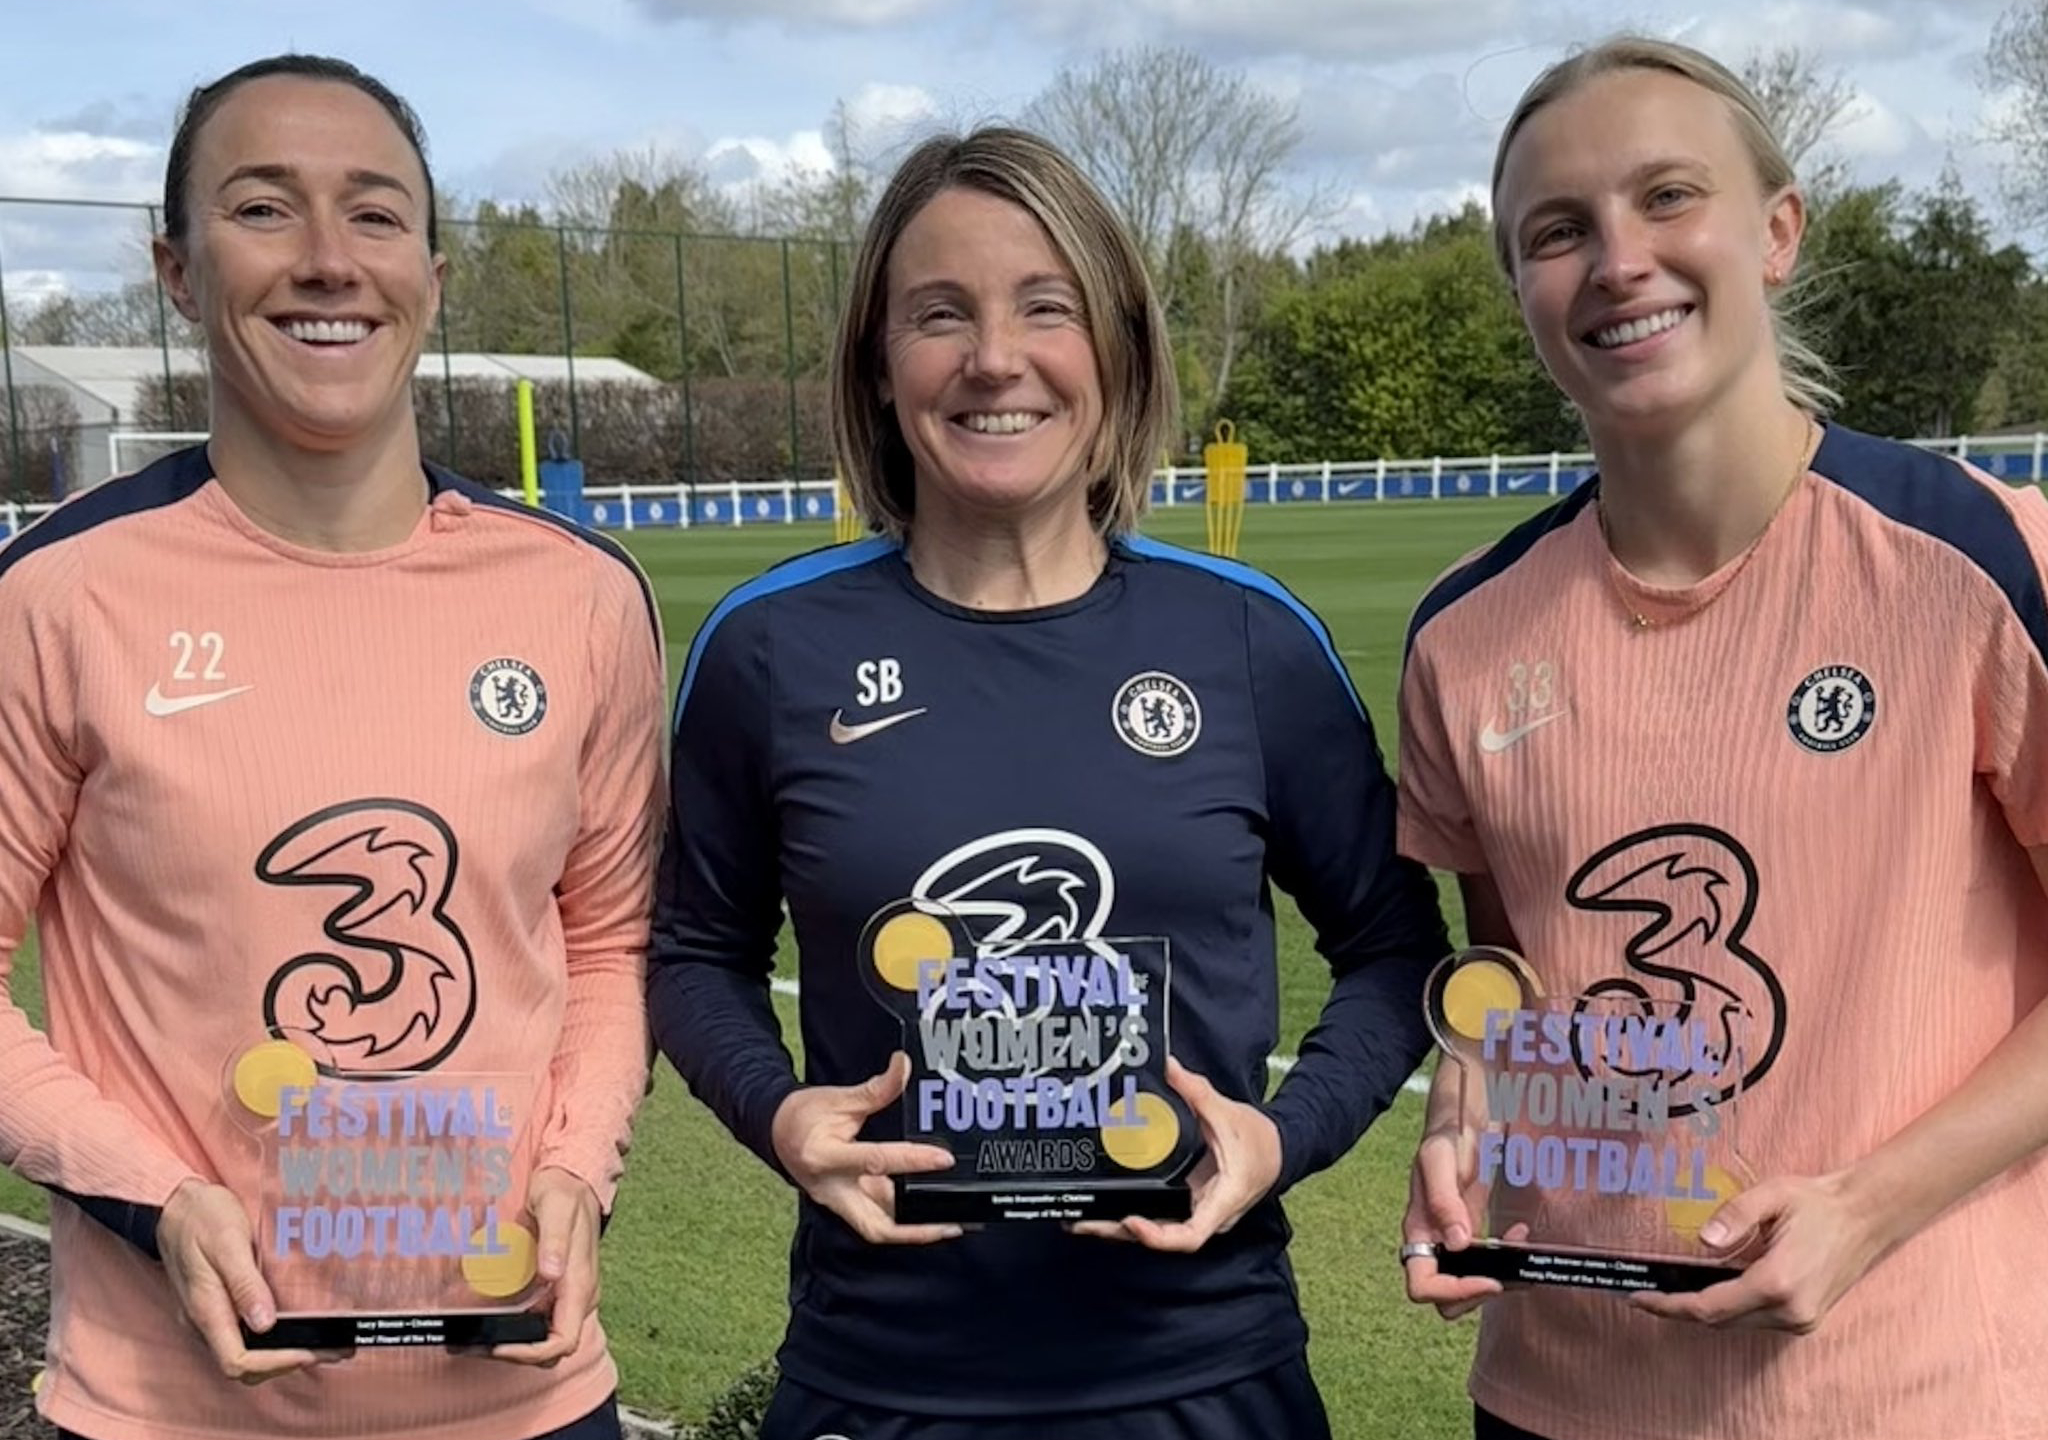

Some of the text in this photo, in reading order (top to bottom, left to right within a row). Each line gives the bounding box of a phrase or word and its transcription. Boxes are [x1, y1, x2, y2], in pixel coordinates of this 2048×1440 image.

[169, 630, 226, 680] 22
[480, 659, 533, 676] CHELSEA
[1804, 667, 1862, 687] CHELSEA
[857, 658, 904, 706] SB
[1128, 679, 1180, 698] CHELSEA
[1507, 662, 1552, 711] 33
[255, 797, 477, 1082] 3
[916, 954, 1149, 1010] FESTIVAL
[919, 1015, 1150, 1071] WOMEN'S
[1483, 1008, 1721, 1076] FESTIVAL
[278, 1085, 513, 1138] FESTIVAL
[919, 1074, 1149, 1132] FOOTBALL
[1487, 1071, 1721, 1137] WOMENS
[279, 1146, 513, 1198] WOMEN'S
[976, 1137, 1096, 1173] AWARDS
[1478, 1132, 1718, 1201] FOOTBALL
[276, 1205, 512, 1260] FOOTBALL
